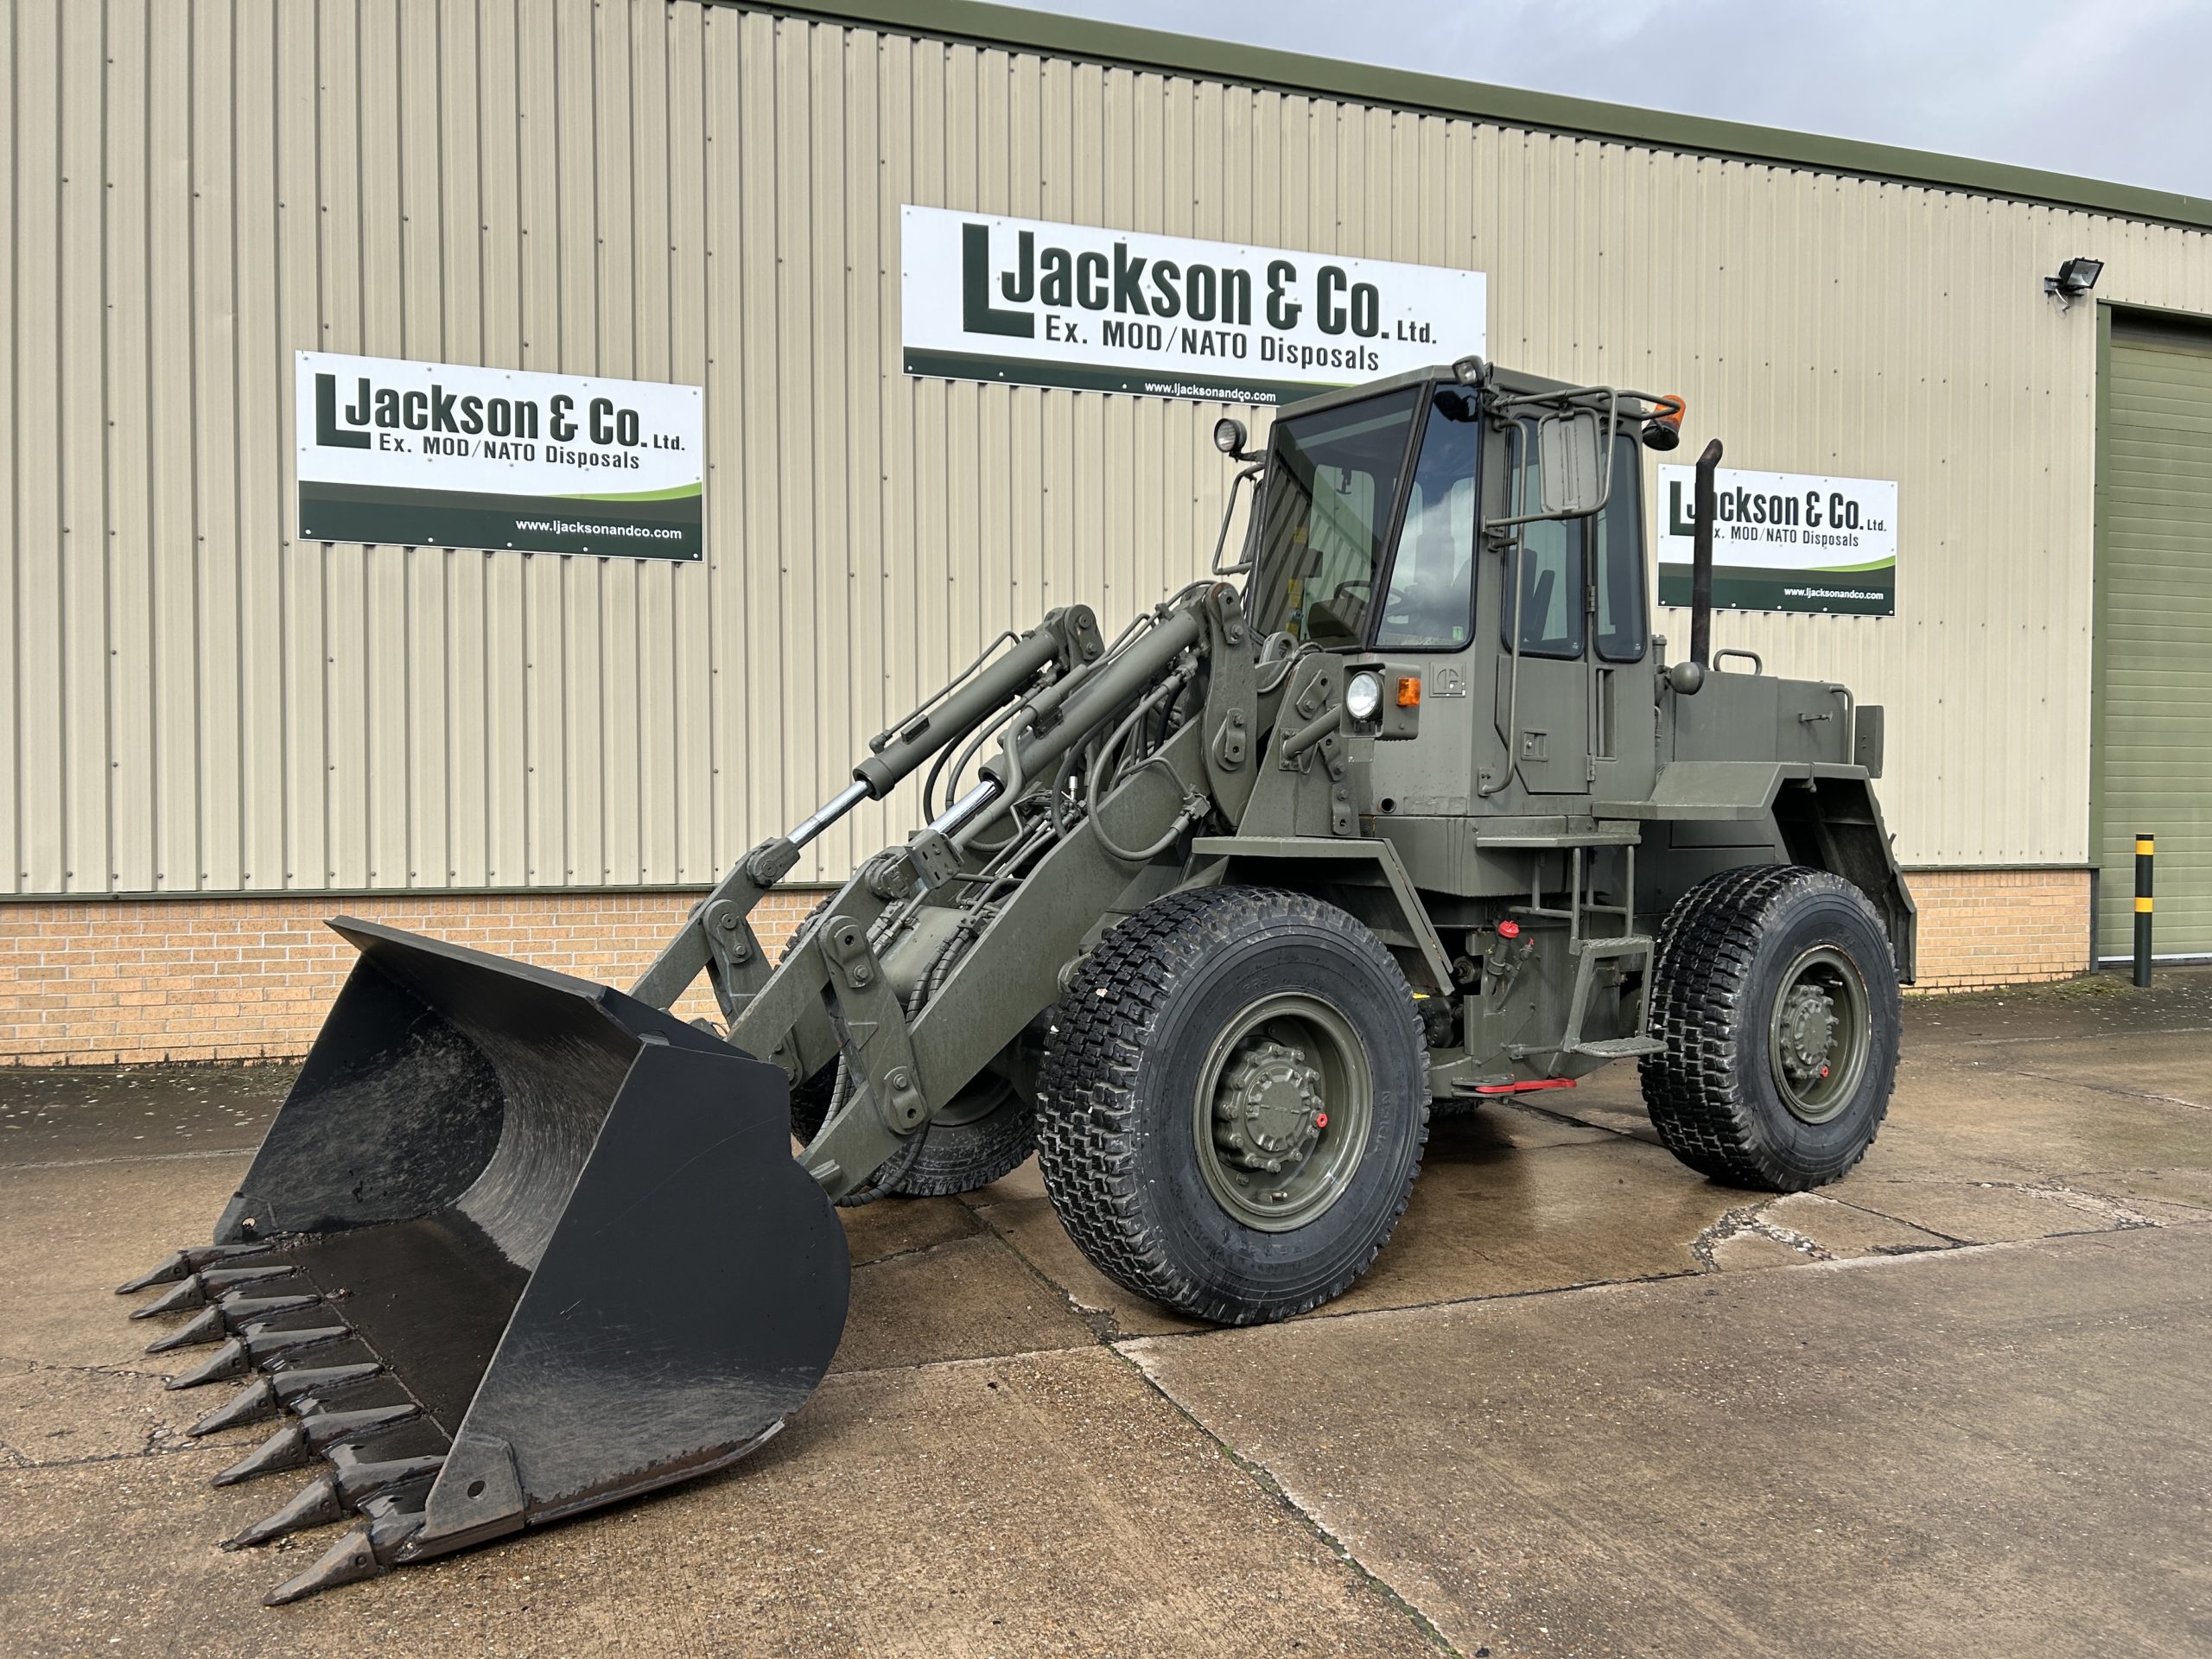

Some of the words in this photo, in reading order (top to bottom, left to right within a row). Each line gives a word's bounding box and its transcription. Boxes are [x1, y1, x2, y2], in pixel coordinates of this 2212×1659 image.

[1266, 259, 1302, 330] &
[1316, 264, 1389, 340] Co.
[1396, 319, 1437, 344] Ltd.
[1046, 315, 1088, 345] Ex.
[1103, 320, 1247, 359] MOD/NATO
[1261, 336, 1380, 372] Disposals
[1144, 382, 1276, 402] www.ljacksonandco.com
[550, 393, 578, 442] &
[588, 397, 648, 448] Co.
[652, 434, 686, 451] Ltd.
[378, 433, 412, 454] Ex.
[423, 435, 536, 461] MOD/NATO
[545, 446, 640, 470] Disposals
[515, 518, 683, 539] www.ljacksonandco.com
[1806, 491, 1822, 528] &
[1829, 493, 1864, 530] Co.
[1866, 518, 1887, 532] Ltd.
[1713, 528, 1725, 539] x.
[1731, 525, 1797, 543] MOD/NATO
[1803, 531, 1859, 548] Disposals
[1783, 588, 1884, 601] www.ljacksonandco.com
